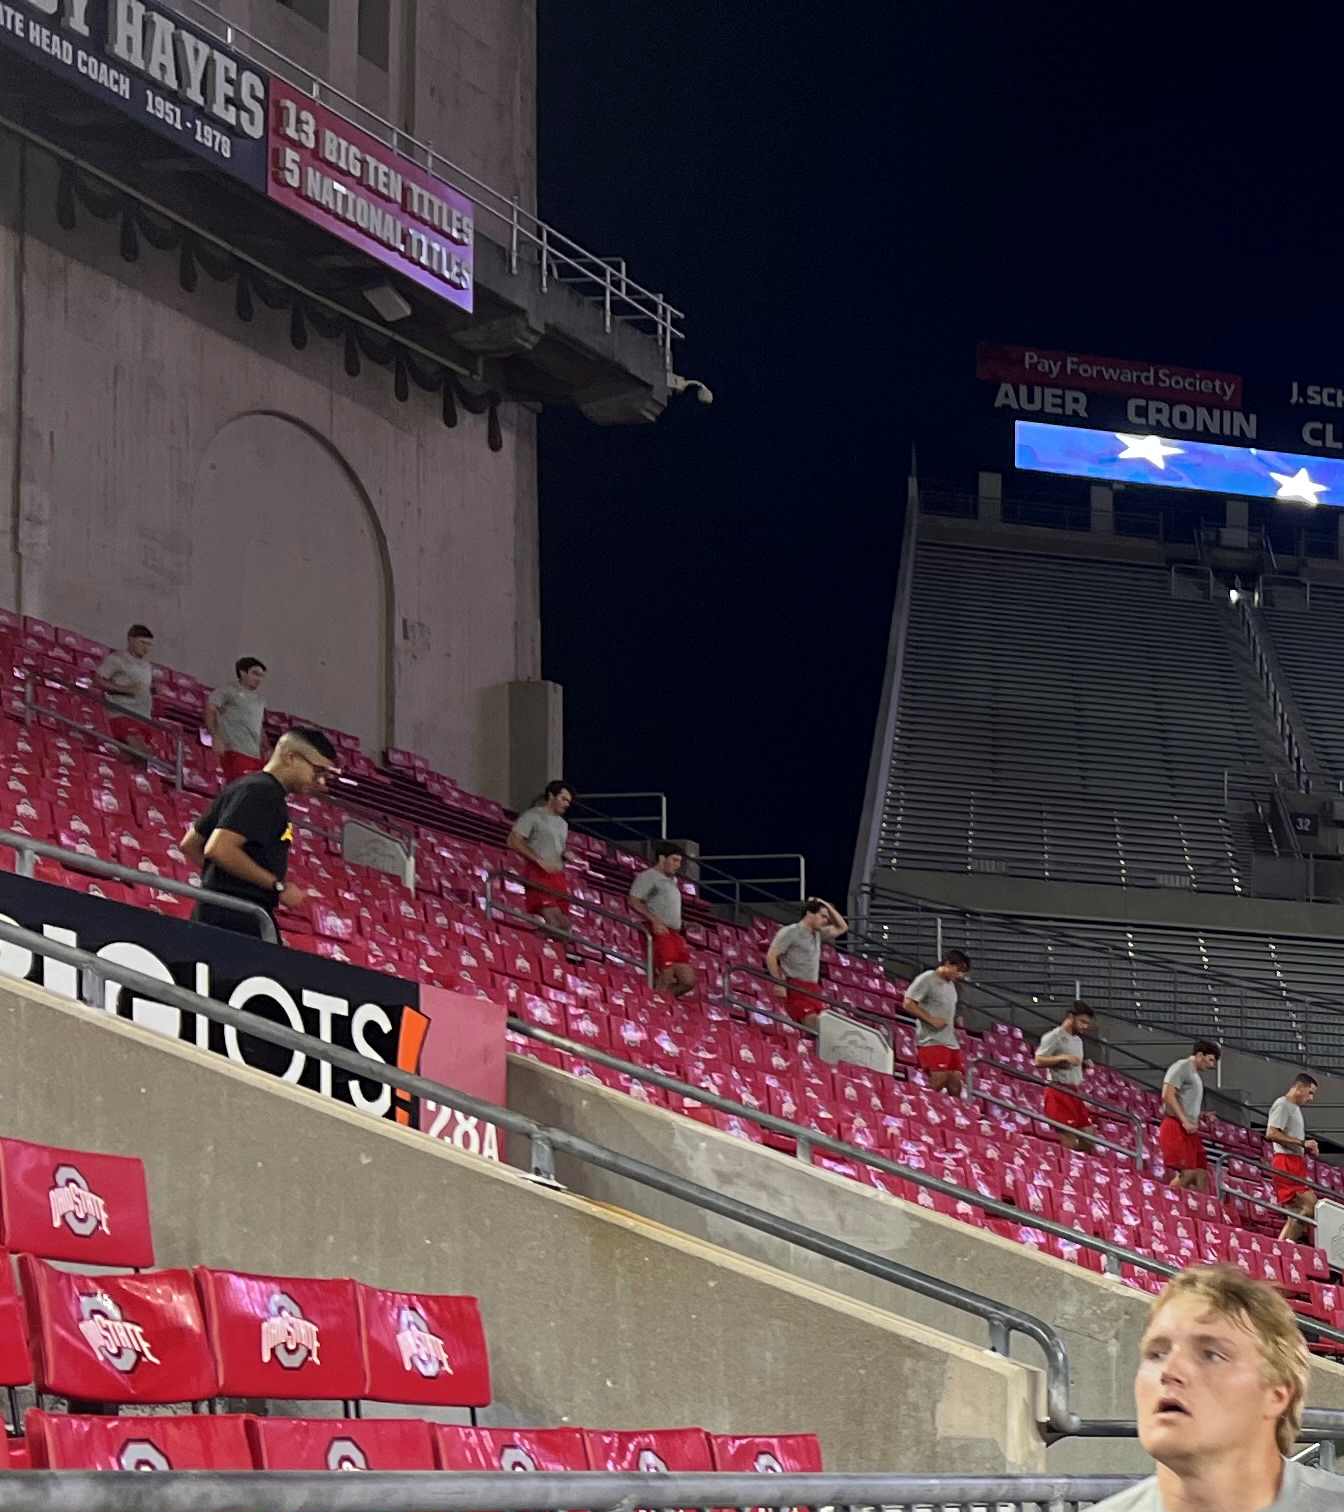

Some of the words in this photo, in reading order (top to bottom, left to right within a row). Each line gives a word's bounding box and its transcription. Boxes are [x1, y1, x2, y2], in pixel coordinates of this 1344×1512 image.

[0, 4, 25, 38] TE
[29, 20, 73, 65] HEAD
[77, 50, 130, 99] COACH
[146, 90, 182, 130] 1951
[195, 120, 231, 158] 1978
[112, 0, 265, 139] HAYES
[280, 99, 316, 149] 13
[324, 129, 362, 177] BIG
[365, 154, 402, 203] TEN
[409, 183, 473, 244] TITLES
[284, 147, 300, 188] 5
[307, 167, 405, 252] NATIONAL
[409, 228, 472, 289] TITLES
[995, 383, 1088, 418] AUER
[1024, 351, 1061, 378] Pay
[1067, 356, 1153, 386] Forward
[1159, 368, 1236, 400] Society
[1127, 398, 1257, 439] CRONIN
